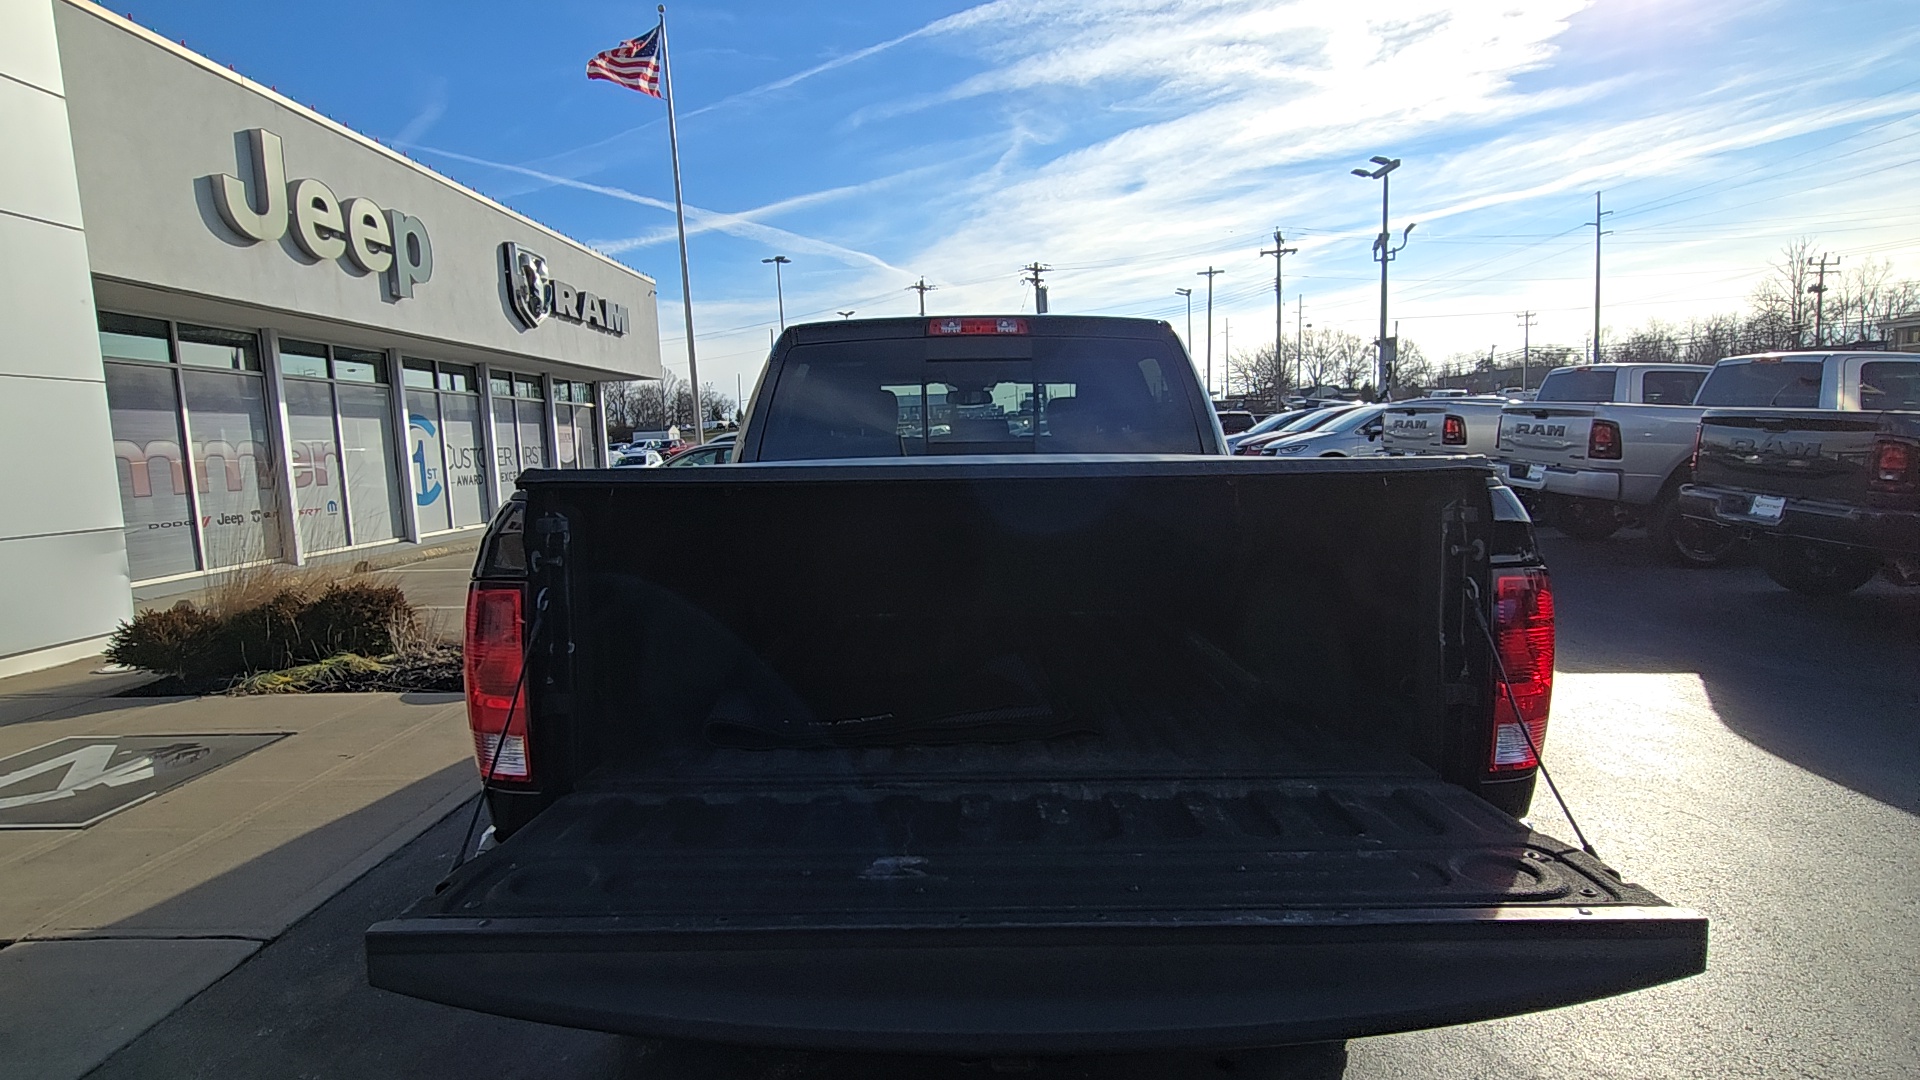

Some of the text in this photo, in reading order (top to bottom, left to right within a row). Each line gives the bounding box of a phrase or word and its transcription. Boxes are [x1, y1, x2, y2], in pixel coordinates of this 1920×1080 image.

[210, 128, 433, 299] Jeep
[549, 279, 630, 335] RAM
[1393, 420, 1428, 430] RAM
[1515, 423, 1566, 437] RAM
[521, 445, 544, 465] IRST
[1730, 438, 1822, 458] RAM
[456, 473, 484, 487] AWARD
[500, 470, 518, 483] EXCE
[148, 520, 196, 530] DODG
[216, 513, 244, 526] Jeep
